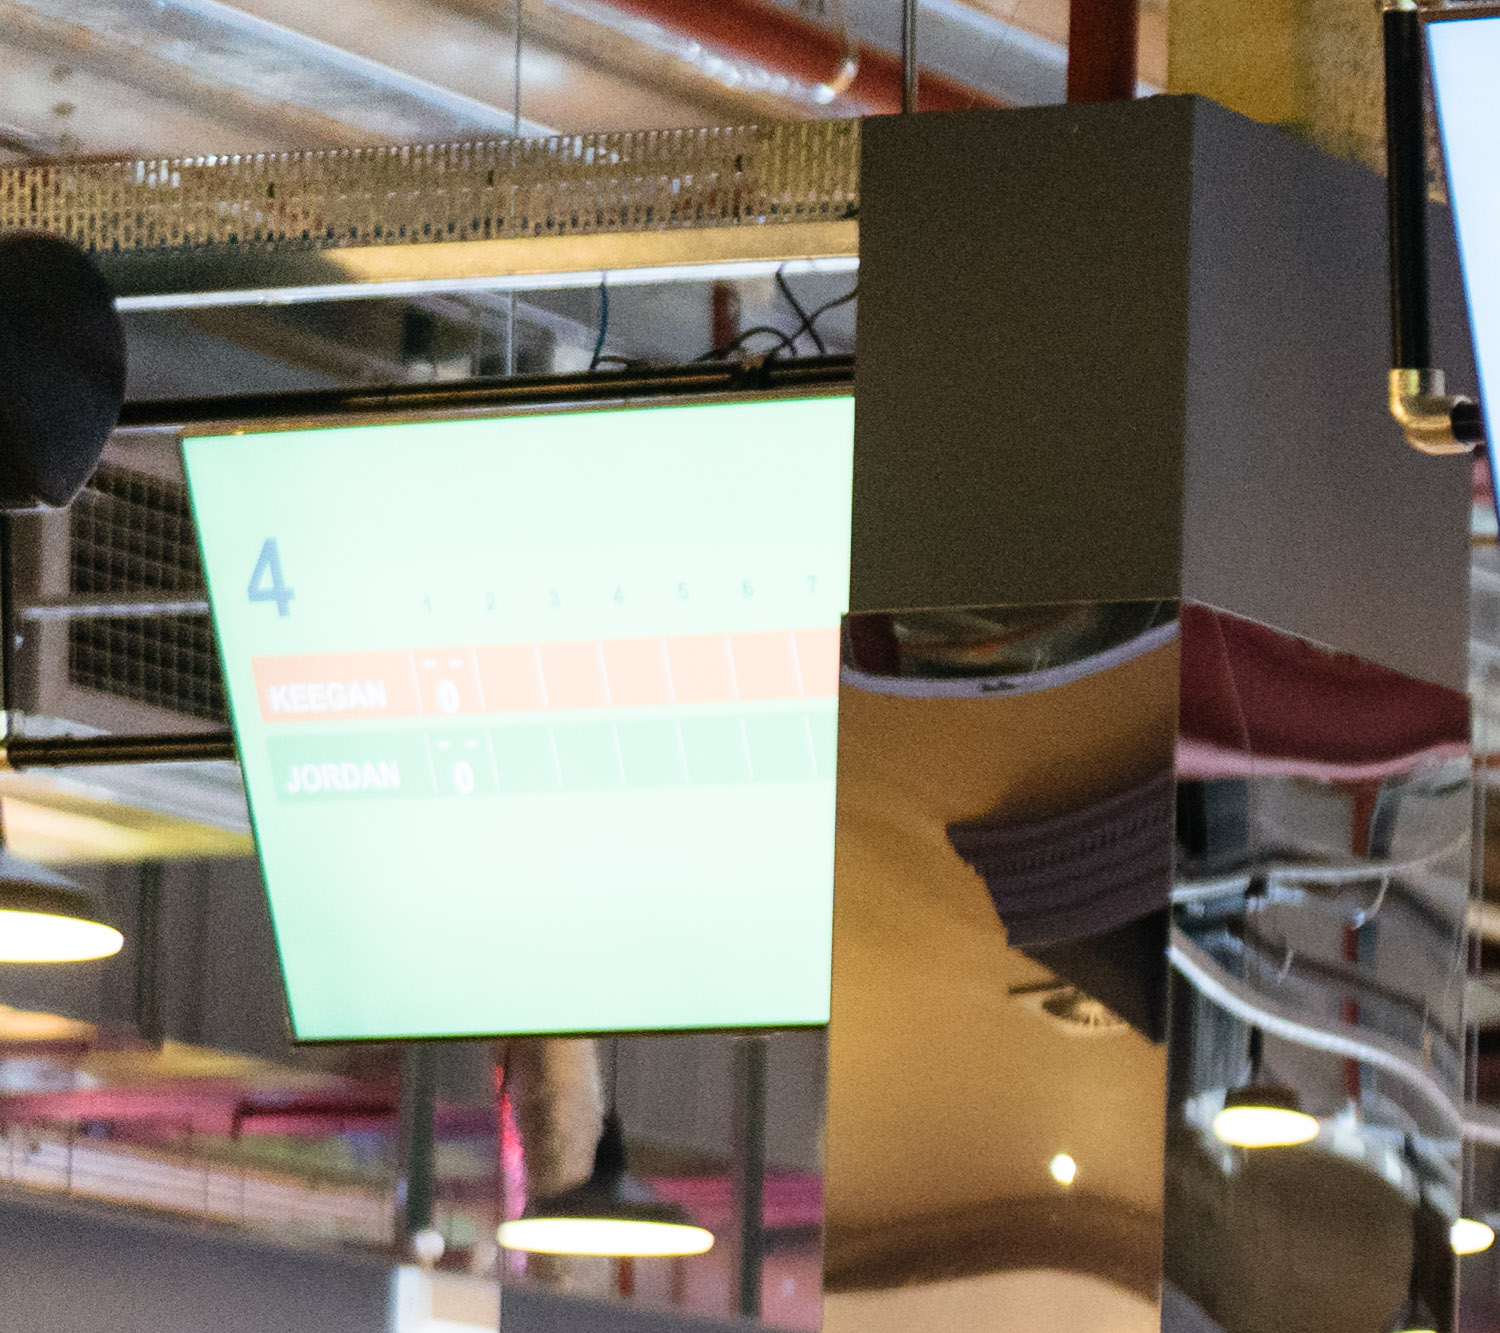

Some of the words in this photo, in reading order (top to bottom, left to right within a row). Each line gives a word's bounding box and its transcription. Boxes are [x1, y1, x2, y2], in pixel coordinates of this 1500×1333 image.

[247, 537, 295, 617] 4
[421, 594, 434, 616] 1
[482, 590, 500, 615] 2
[546, 586, 564, 611] 3
[609, 583, 628, 608] 4
[673, 579, 692, 604] 5
[738, 576, 757, 601] 6
[803, 572, 819, 595] 7
[266, 680, 389, 713] KEEGAN
[435, 679, 461, 715] 0
[285, 760, 402, 794] JORDAN
[450, 760, 476, 796] 0
